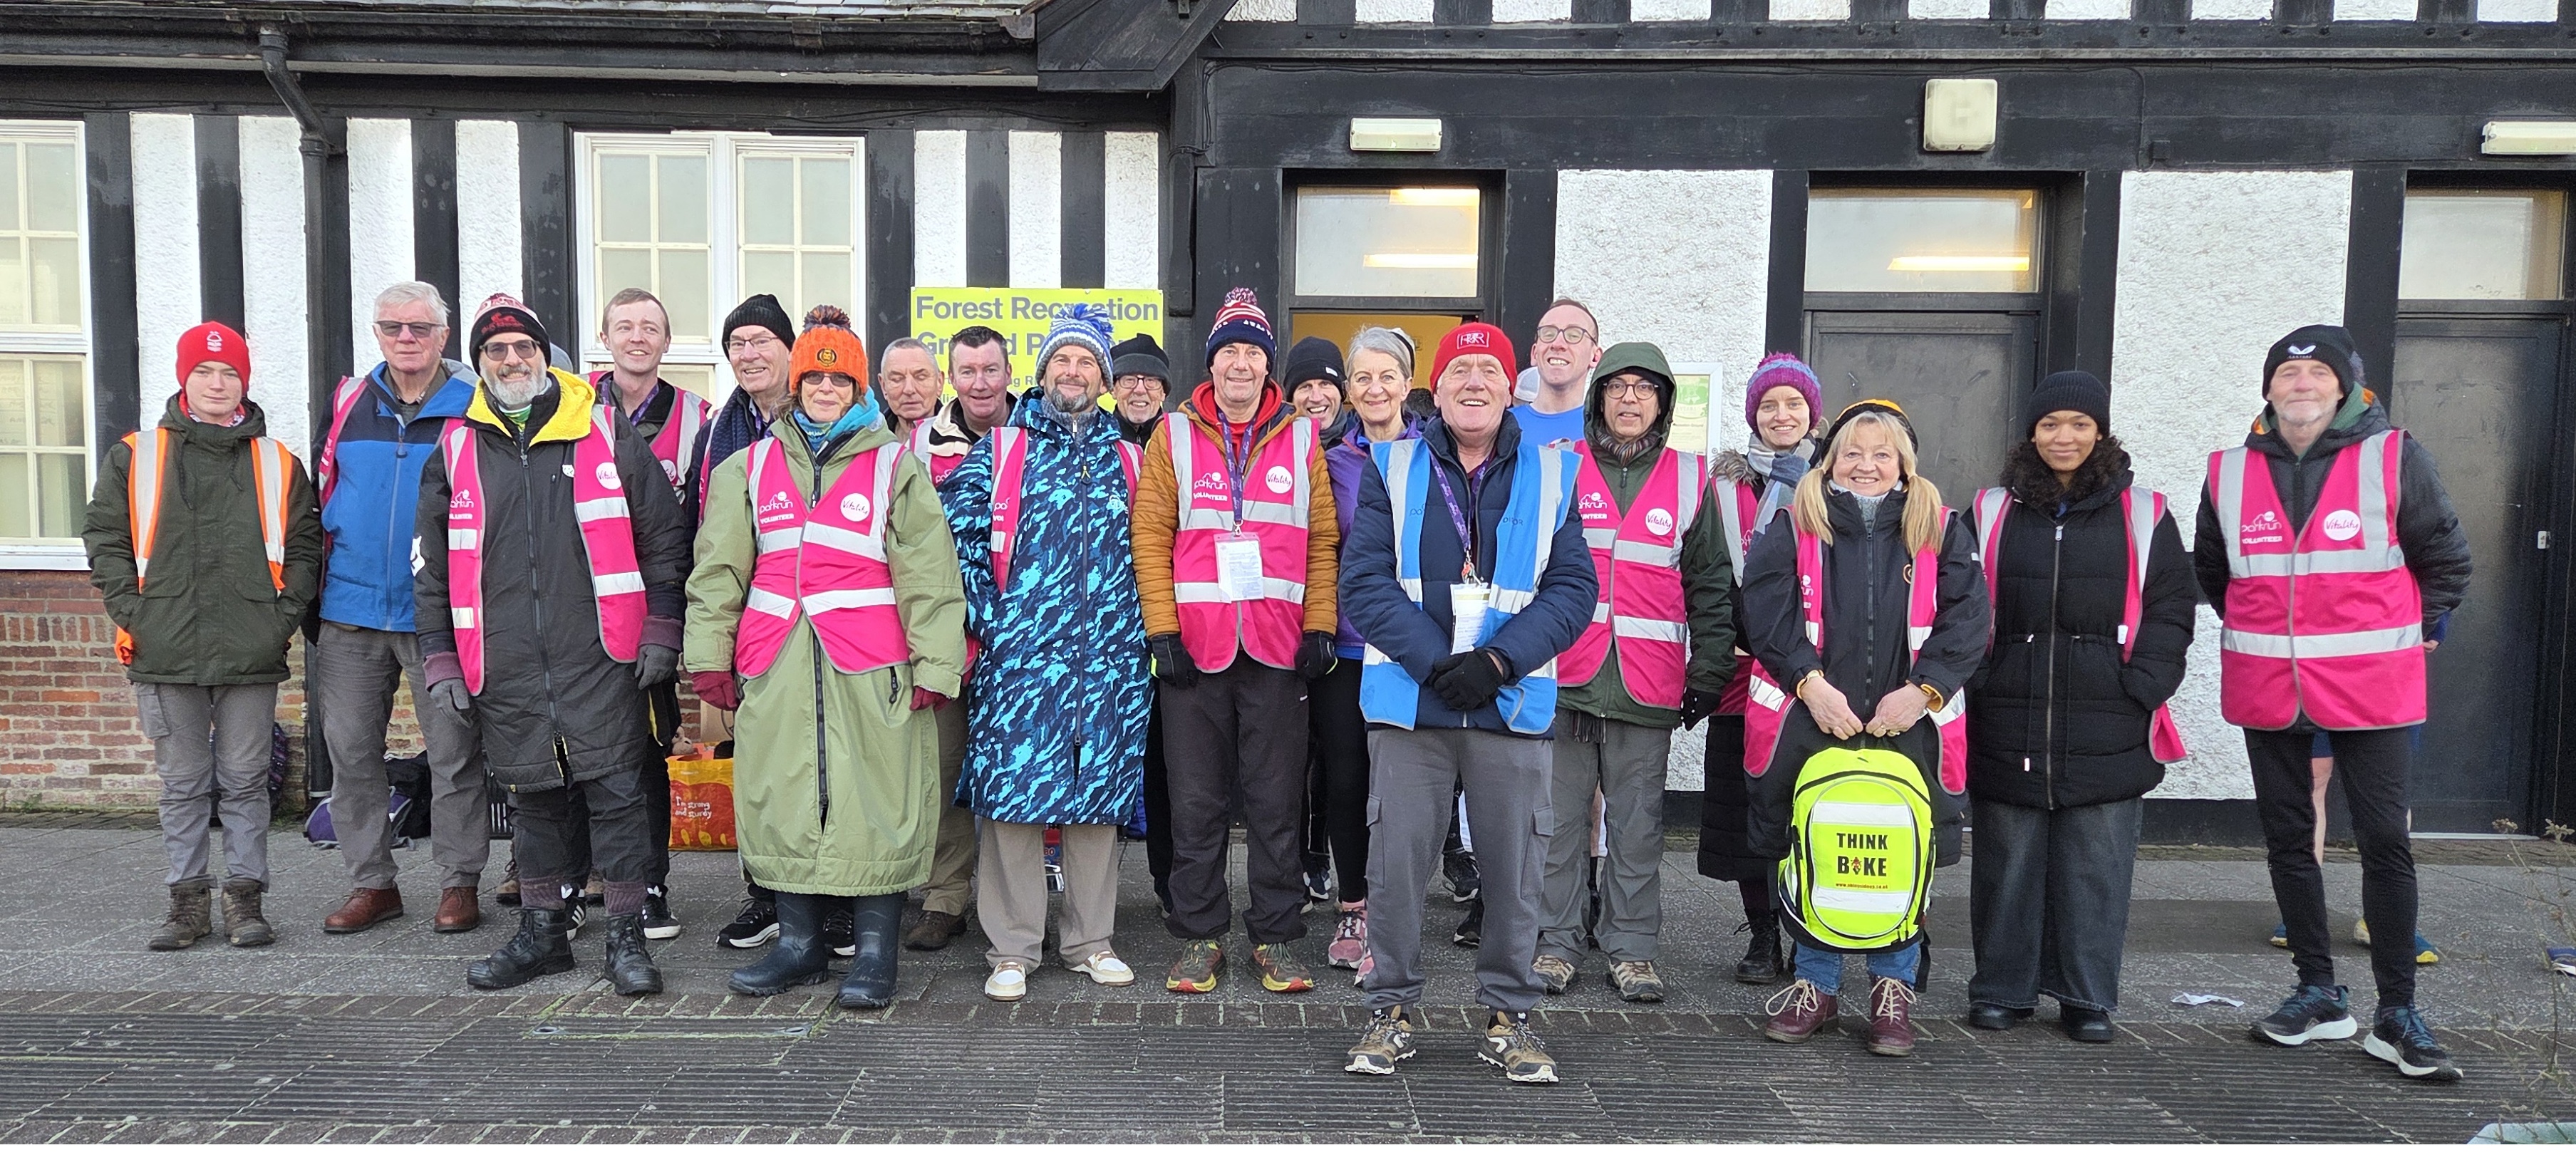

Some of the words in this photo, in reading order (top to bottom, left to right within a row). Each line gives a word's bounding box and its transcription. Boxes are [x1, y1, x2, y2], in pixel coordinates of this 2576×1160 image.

[916, 296, 1003, 319] Forest
[1011, 296, 1158, 321] Rection
[917, 331, 1017, 356] Grd
[1194, 475, 1228, 490] parkrun
[1267, 472, 1291, 487] Vitality
[450, 493, 475, 508] arkrun
[759, 494, 794, 515] parkrun
[1193, 492, 1228, 502] VOLUNTEER
[843, 500, 869, 514] Vitality
[760, 513, 795, 524] VOLUNTEER
[1647, 513, 1672, 529] Vitality
[2326, 519, 2359, 531] Vitality
[675, 807, 687, 817] and
[688, 808, 712, 820] sturdy
[688, 802, 710, 810] strong
[1836, 832, 1888, 850] THINK
